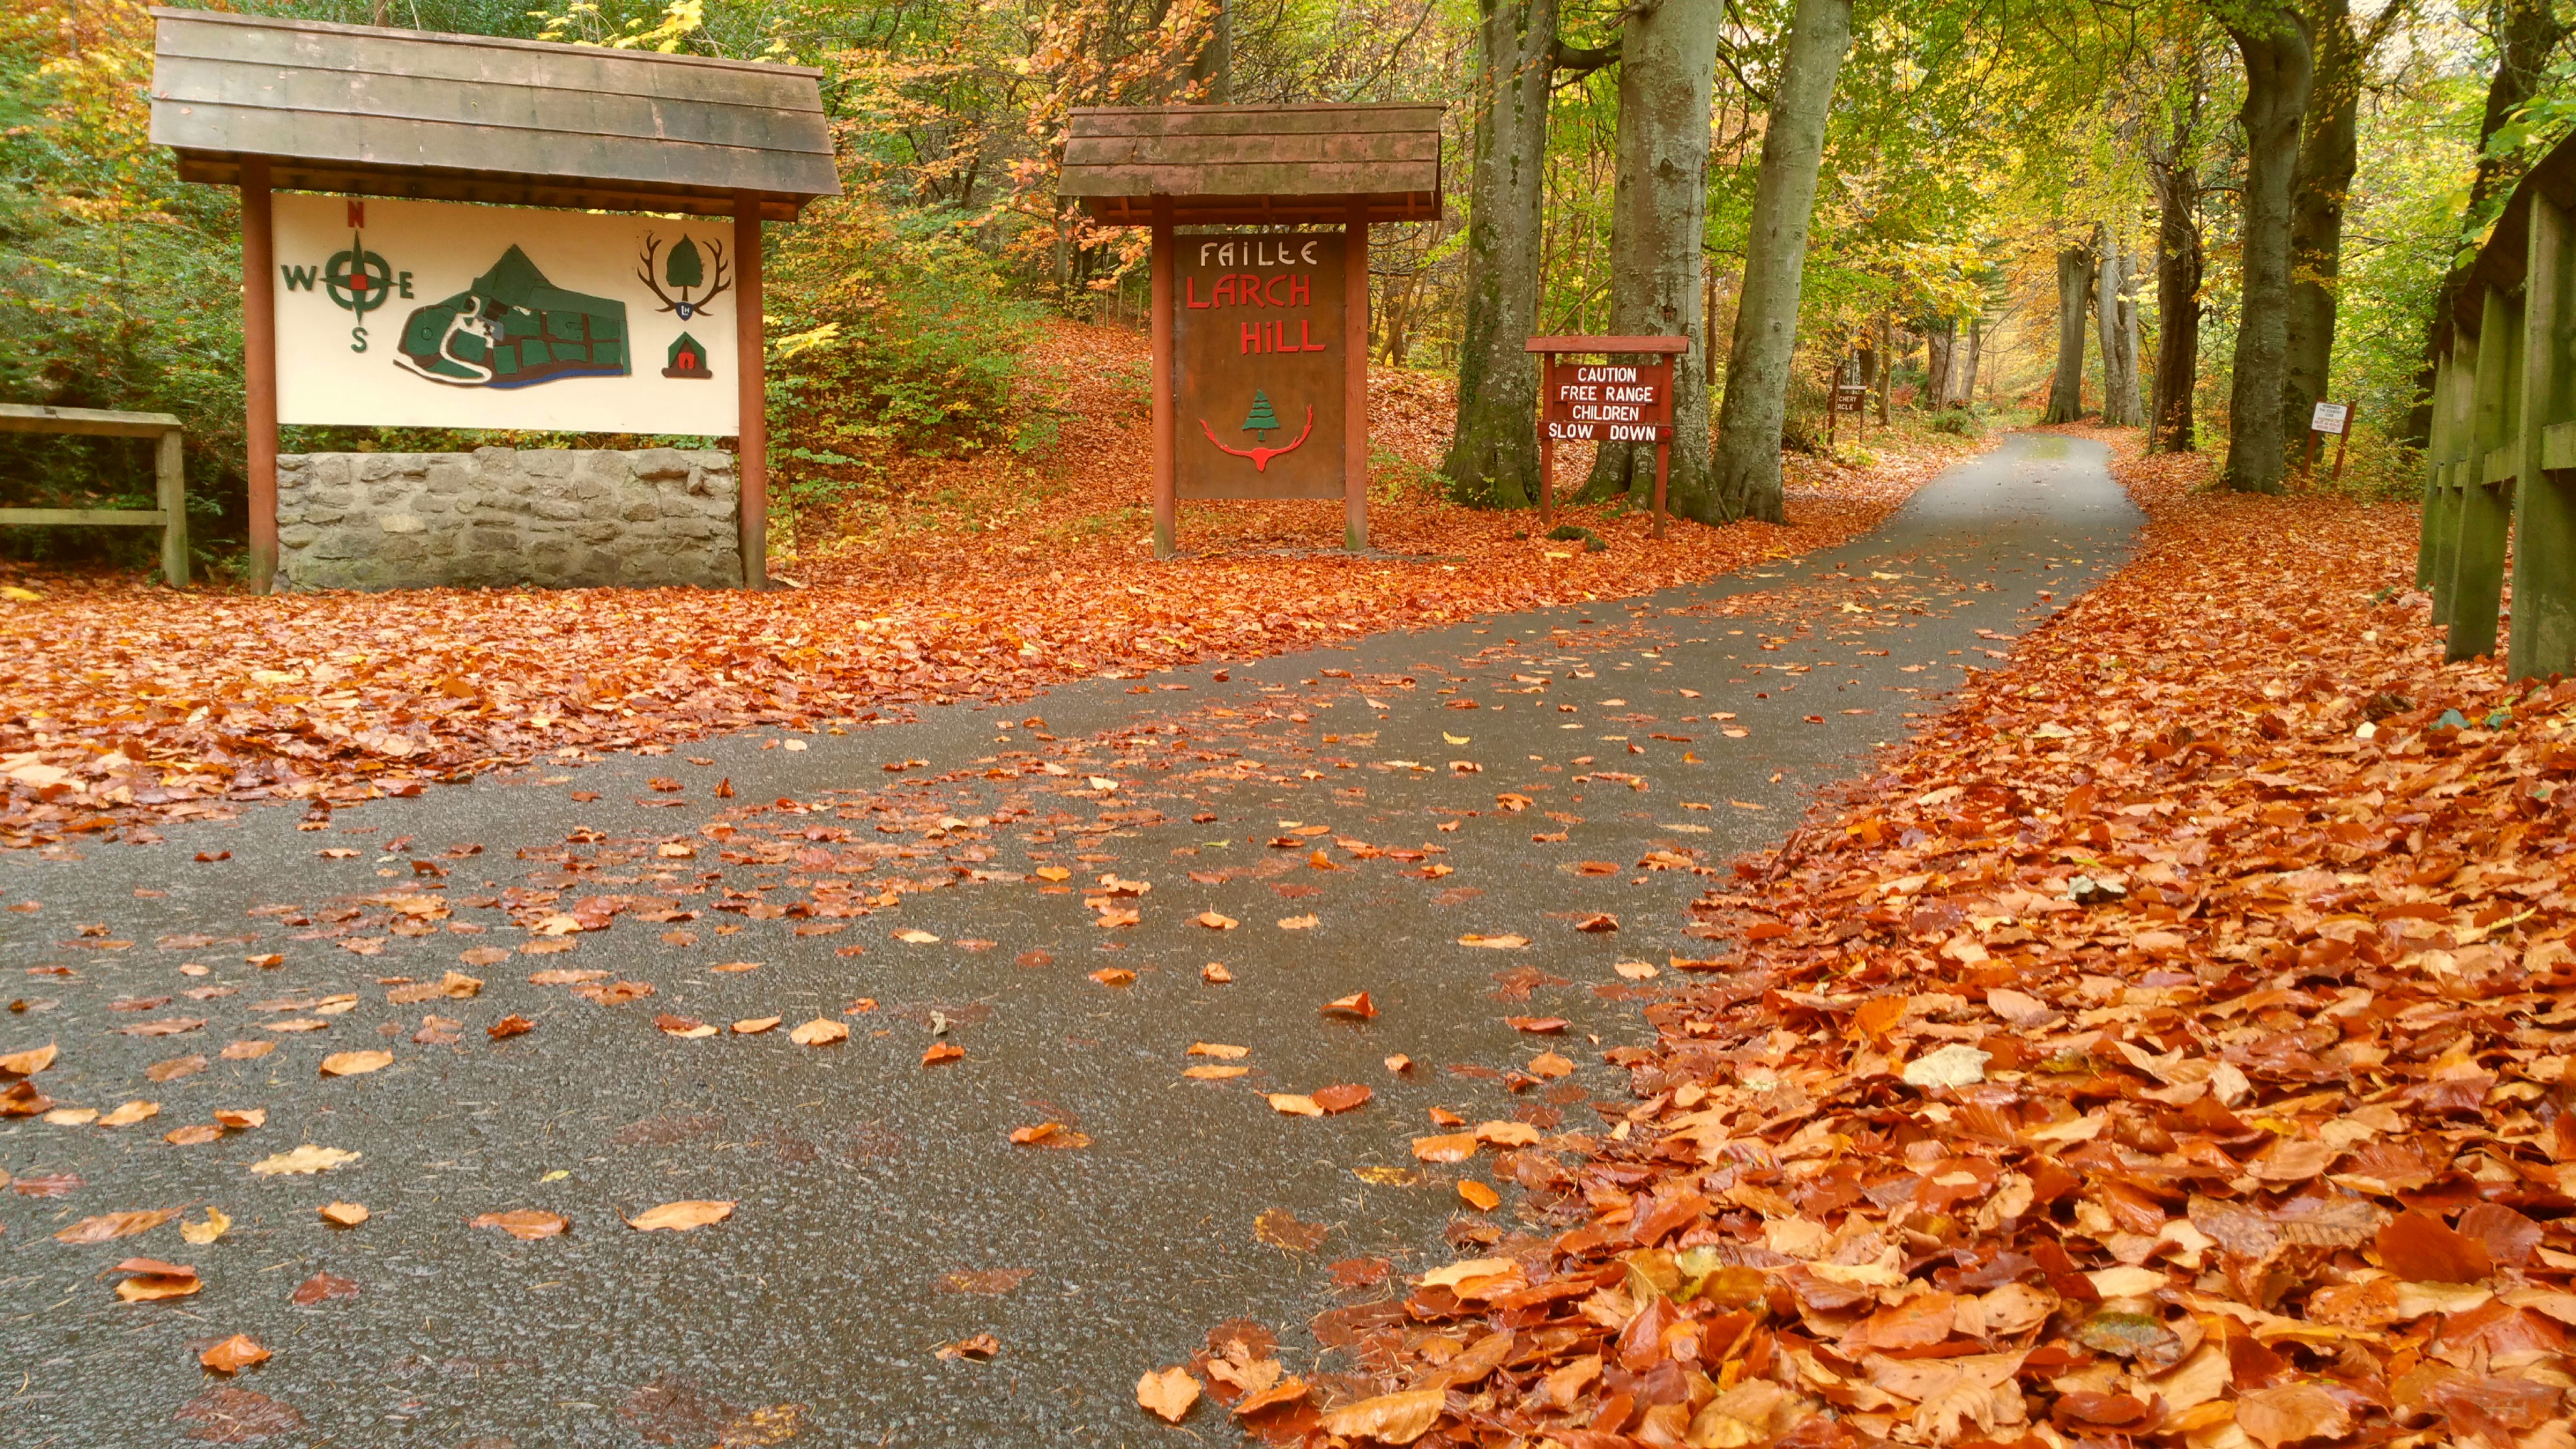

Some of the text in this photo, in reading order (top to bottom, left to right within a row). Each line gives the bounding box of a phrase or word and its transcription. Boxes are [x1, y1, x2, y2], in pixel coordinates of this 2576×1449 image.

[347, 200, 364, 229] N
[281, 264, 317, 291] W
[399, 271, 414, 299] E
[1187, 274, 1310, 309] LARCH
[350, 327, 368, 353] S
[1241, 320, 1326, 354] HILL
[1578, 367, 1637, 383] CAUTION
[1560, 385, 1653, 402] FREE RANGE
[1573, 405, 1639, 421] CHILDREN
[1549, 422, 1656, 441] SLOW DOWN
